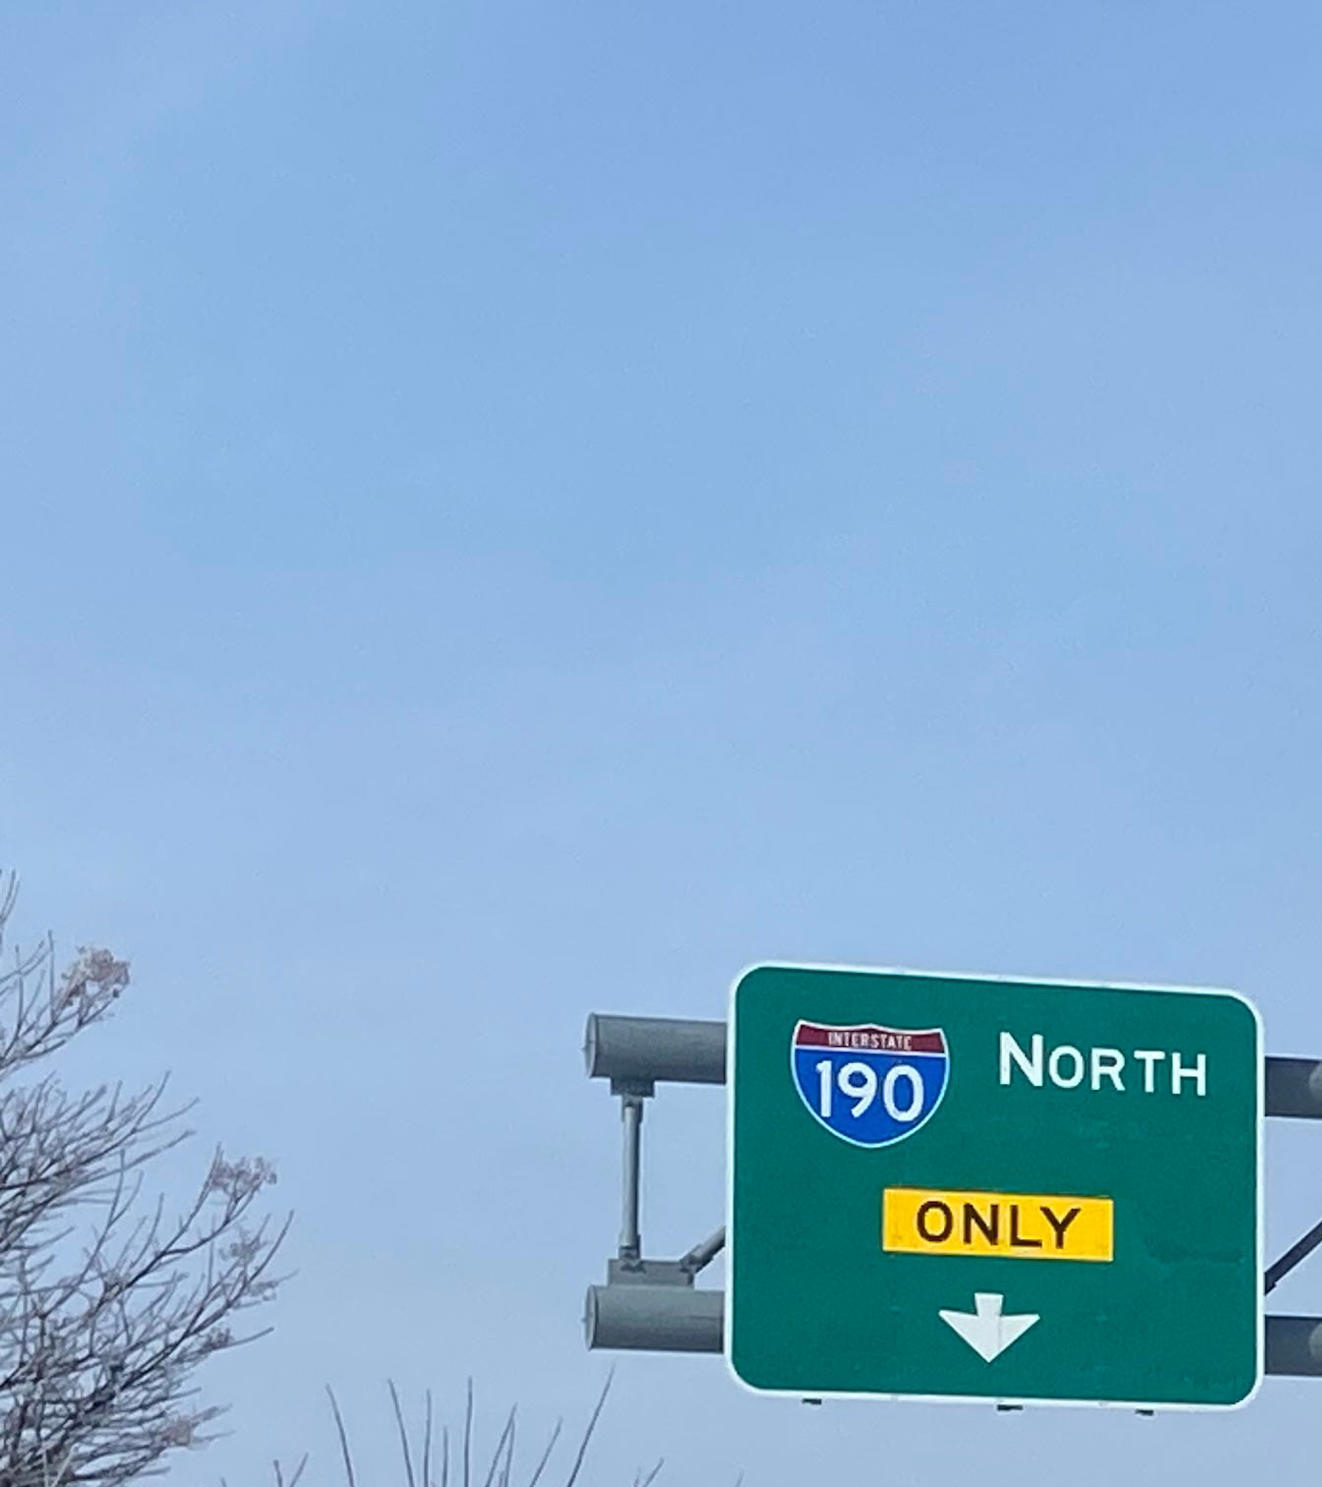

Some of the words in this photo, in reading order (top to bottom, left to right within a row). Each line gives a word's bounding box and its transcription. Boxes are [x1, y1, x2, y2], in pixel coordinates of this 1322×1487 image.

[827, 1031, 913, 1052] INTERSTATE
[1000, 1031, 1207, 1097] NORTH
[815, 1059, 924, 1123] 190
[916, 1200, 1082, 1249] ONLY
